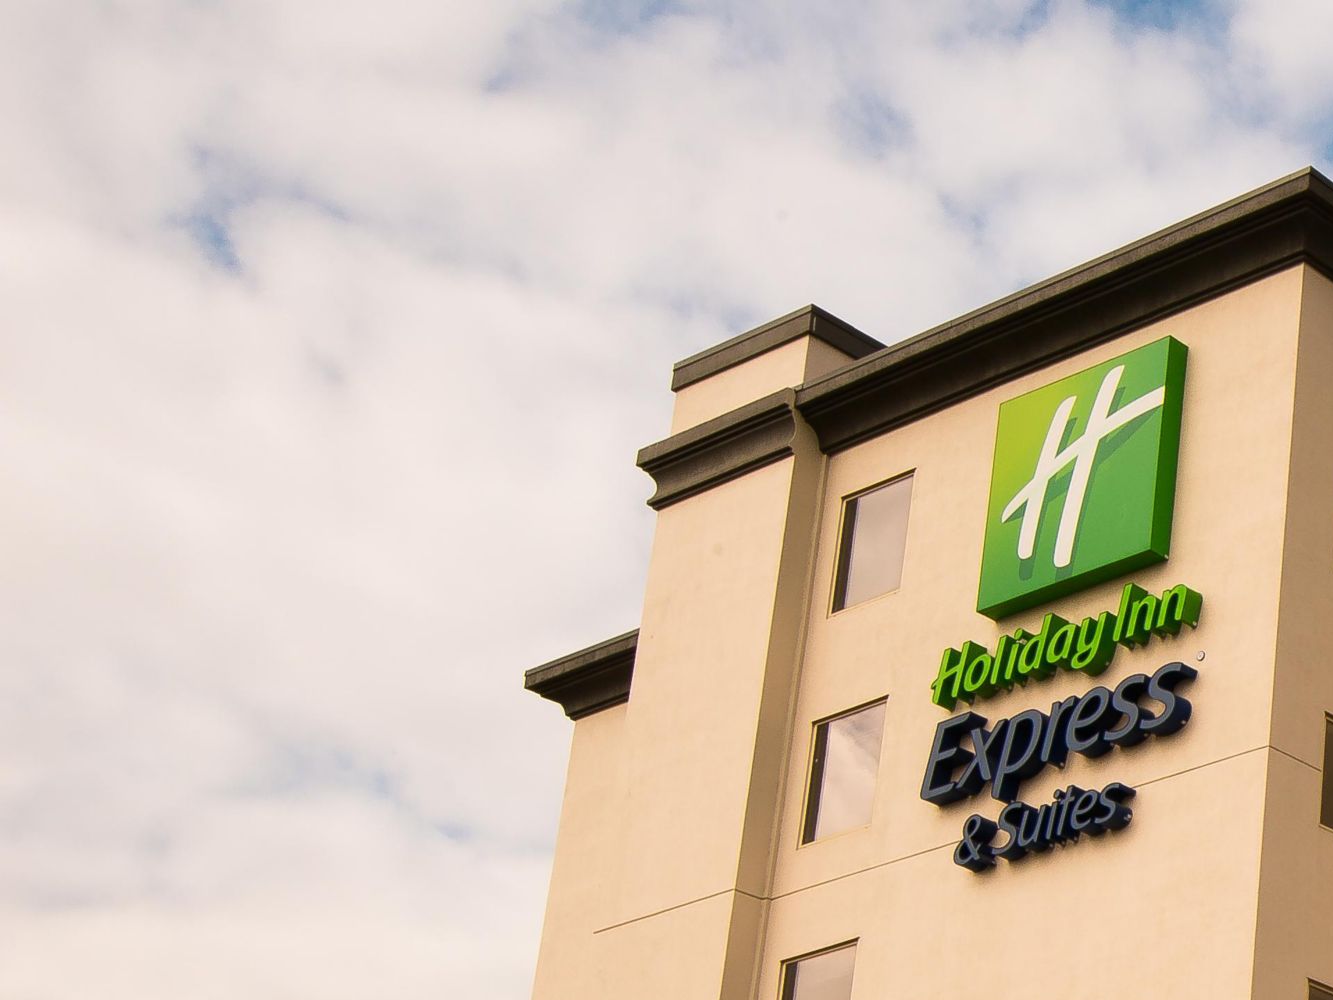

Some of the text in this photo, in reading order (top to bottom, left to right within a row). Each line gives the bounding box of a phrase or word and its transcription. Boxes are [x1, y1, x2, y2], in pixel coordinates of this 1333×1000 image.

[931, 582, 1194, 706] Holiday Inn
[921, 662, 1190, 802] Express
[954, 782, 1126, 868] & Suites
